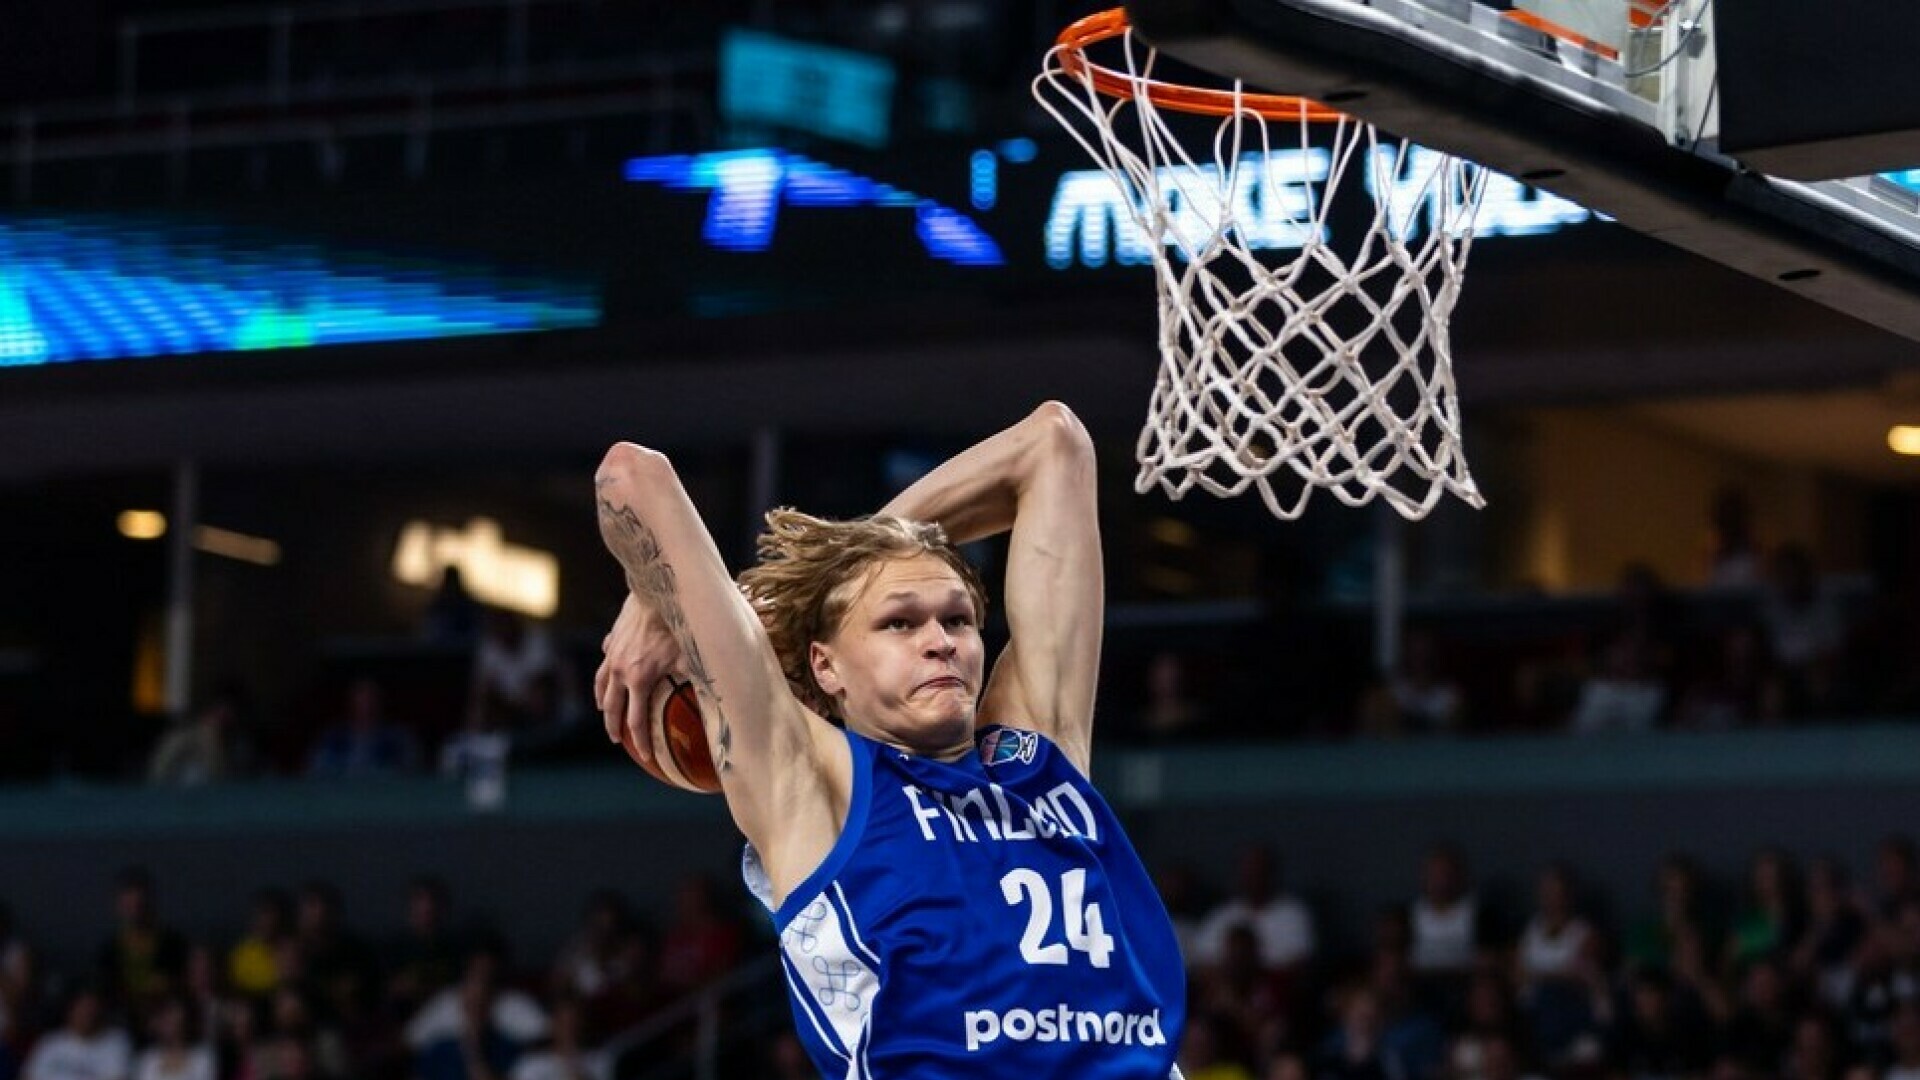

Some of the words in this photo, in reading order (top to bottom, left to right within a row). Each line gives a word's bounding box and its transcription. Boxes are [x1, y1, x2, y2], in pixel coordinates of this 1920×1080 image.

[1364, 142, 1617, 242] YOU
[1000, 868, 1115, 968] 24
[965, 1004, 1166, 1051] postnord
